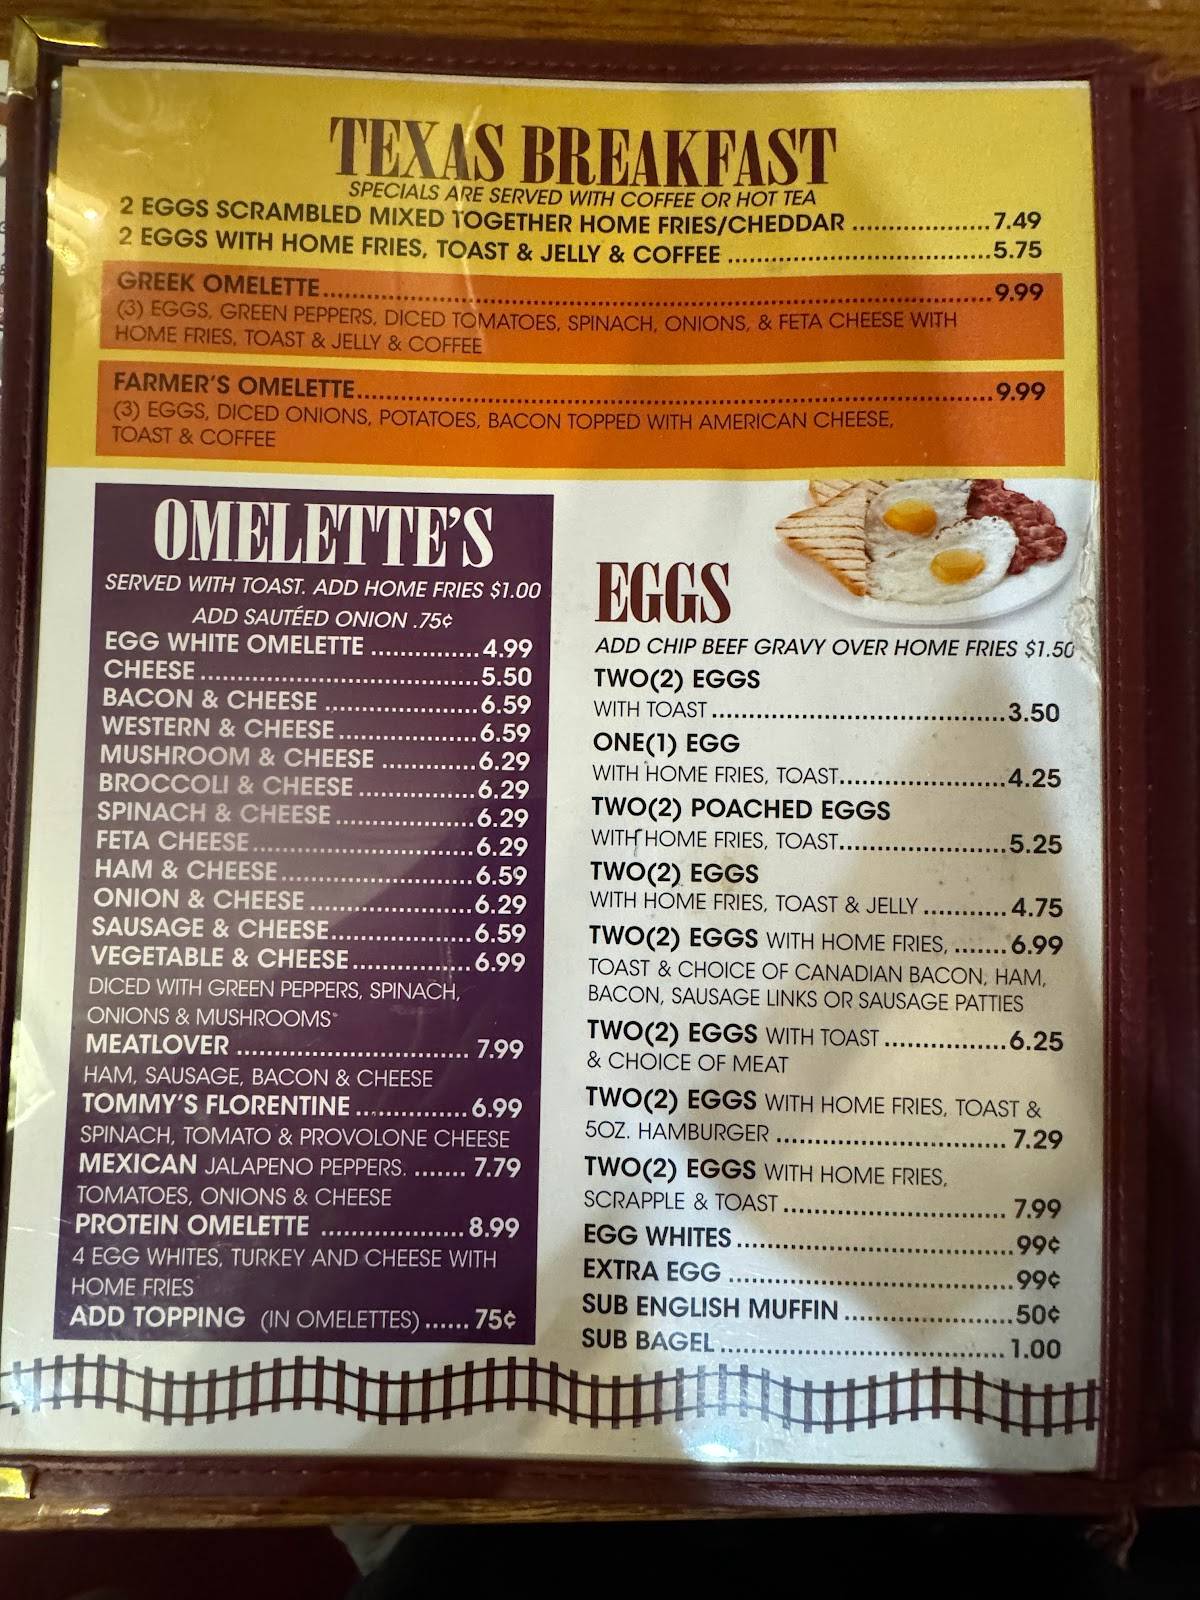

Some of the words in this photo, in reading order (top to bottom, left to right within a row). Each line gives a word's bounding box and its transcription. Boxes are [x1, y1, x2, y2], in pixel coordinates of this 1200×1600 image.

[330, 116, 504, 181] TEXAS
[520, 125, 836, 187] BREAKFAST
[348, 181, 440, 200] SPECIALS
[444, 185, 484, 202] ARE
[489, 187, 563, 205] SERVED
[570, 190, 615, 207] WITH
[621, 191, 696, 208] COFFEE
[701, 192, 731, 208] OR
[736, 191, 778, 207] HOT
[784, 189, 816, 206] TEA
[120, 196, 133, 214] 2
[142, 197, 209, 218] EGGS
[216, 200, 361, 224] SCRAMBLED
[370, 206, 445, 228] MIXED
[452, 210, 572, 232] TOGETHER
[580, 215, 650, 234] HOME
[659, 213, 844, 236] FRIES/CHEDDAR
[994, 211, 1042, 230] 7.49
[117, 271, 195, 292] GREEK
[203, 274, 319, 297] OMELETTE
[995, 283, 1044, 302] 9.99
[114, 372, 230, 394] FARMER'S
[238, 376, 354, 399] OMELETTE
[996, 382, 1046, 401] 9.99
[113, 400, 140, 422] (3)
[148, 401, 209, 421] EGGS,
[217, 403, 279, 422] DICED
[285, 405, 371, 426] ONIONS,
[380, 409, 480, 429] POTATOES,
[488, 412, 561, 429] BACON
[567, 413, 641, 430] TOPPED
[647, 414, 692, 430] WITH
[699, 412, 807, 430] AMERICAN
[813, 410, 893, 428] CHEESE,
[112, 425, 173, 444] TOAST
[179, 428, 194, 445] &
[200, 428, 276, 447] COFFEE
[154, 498, 493, 568] OMELETTE'S
[105, 573, 181, 591] SERVED
[189, 575, 236, 593] WITH
[243, 577, 305, 594] TOAST.
[312, 579, 358, 596] ADD
[364, 580, 428, 597] HOME
[432, 581, 484, 598] FRIES
[490, 581, 541, 599] $1.00
[594, 562, 731, 624] EGGS
[192, 607, 238, 624] ADD
[244, 605, 329, 626] SAUTÉED
[335, 610, 408, 628] ONION
[413, 612, 453, 629] .75¢
[105, 631, 159, 651] EGG
[167, 632, 239, 652] WHITE
[247, 634, 364, 655] OMELETTE
[483, 639, 533, 658] 4.99
[595, 637, 640, 654] ADD
[647, 637, 697, 654] CHIP
[702, 638, 749, 655] BEEF
[754, 638, 826, 655] GRAVY
[832, 639, 888, 656] OVER
[894, 639, 960, 656] HOME
[965, 640, 1018, 657] FRIES
[1025, 639, 1075, 658] $1.50
[594, 668, 683, 692] TWO(2)
[693, 669, 760, 689] EGGS
[103, 687, 193, 708] BACON
[202, 689, 218, 709] &
[227, 690, 317, 710] CHEESE
[481, 695, 531, 714] 6.59
[593, 700, 639, 717] WITH
[646, 701, 707, 718] TOAST
[1008, 702, 1060, 723] 3.50
[100, 744, 250, 766] MUSHROOM
[258, 747, 275, 766] &
[284, 748, 374, 768] CHEESE
[479, 751, 530, 771] 6.29
[593, 732, 677, 756] ONE(1)
[687, 733, 740, 753] EGG
[591, 796, 682, 821] TWO(2)
[692, 798, 812, 819] POACHED
[822, 800, 890, 821] EGGS
[94, 887, 179, 908] ONION
[188, 889, 205, 908] &
[213, 889, 304, 910] CHEESE
[475, 894, 527, 914] 6.29
[92, 916, 204, 937] SAUSAGE
[212, 918, 229, 938] &
[238, 919, 329, 940] CHEESE
[475, 923, 526, 943] 6.59
[91, 945, 224, 967] VEGETABLE
[232, 947, 248, 967] &
[257, 948, 348, 969] CHEESE
[475, 952, 525, 972] 6.99
[589, 984, 664, 1005] BACON,
[672, 987, 760, 1006] SAUSAGE
[767, 989, 817, 1008] LINKS
[824, 991, 853, 1008] OR
[859, 991, 948, 1011] SAUSAGE
[956, 994, 1024, 1013] PATTIES
[86, 1033, 229, 1055] MEATLOVER
[477, 1039, 524, 1059] 7.99
[587, 1019, 679, 1046] TWO(2)
[689, 1022, 758, 1044] EGGS
[766, 1027, 813, 1046] WITH
[820, 1028, 879, 1047] TOAST
[1010, 1030, 1064, 1052] 6.25
[84, 1065, 137, 1085] HAM,
[145, 1066, 243, 1086] SAUSAGE,
[252, 1068, 328, 1086] BACON
[335, 1069, 350, 1087] &
[357, 1069, 433, 1087] CHEESE
[82, 1092, 198, 1114] TOMMY'S
[206, 1094, 350, 1116] FLORENTINE
[472, 1098, 522, 1118] 6.99
[585, 1086, 678, 1113] TWO(2)
[688, 1089, 757, 1110] EGGS
[765, 1093, 813, 1113] WITH
[822, 1096, 885, 1114] HOME
[892, 1097, 947, 1117] FRIES,
[955, 1099, 1020, 1118] TOAST
[1026, 1100, 1042, 1119] &
[80, 1125, 175, 1146] SPINACH,
[183, 1126, 271, 1145] TOMATO
[278, 1128, 293, 1145] &
[300, 1128, 427, 1147] PROVOLONE
[434, 1129, 510, 1148] CHEESE
[639, 1122, 769, 1142] HAMBURGER
[1013, 1128, 1063, 1149] 7.29
[75, 1213, 178, 1235] PROTEIN
[187, 1214, 309, 1236] OMELETTE
[469, 1217, 519, 1238] 8.99
[584, 1223, 638, 1245] EGG
[645, 1226, 731, 1248] WHITES
[1017, 1235, 1060, 1255] 99¢
[584, 1258, 659, 1281] EXTRA
[667, 1261, 721, 1283] EGG
[1017, 1269, 1060, 1290] 99¢
[69, 1305, 125, 1327] ADD
[133, 1306, 245, 1328] TOPPING
[261, 1310, 290, 1333] (IN
[296, 1310, 419, 1334] OMELETTES)
[475, 1308, 516, 1330] 75¢
[582, 1293, 628, 1315] SUB
[637, 1296, 739, 1318] ENGLISH
[749, 1298, 838, 1320] MUFFIN
[1016, 1304, 1060, 1325] 50¢
[582, 1327, 627, 1349] SUB
[636, 1330, 715, 1352] BAGEL
[1011, 1338, 1061, 1359] 1.00
